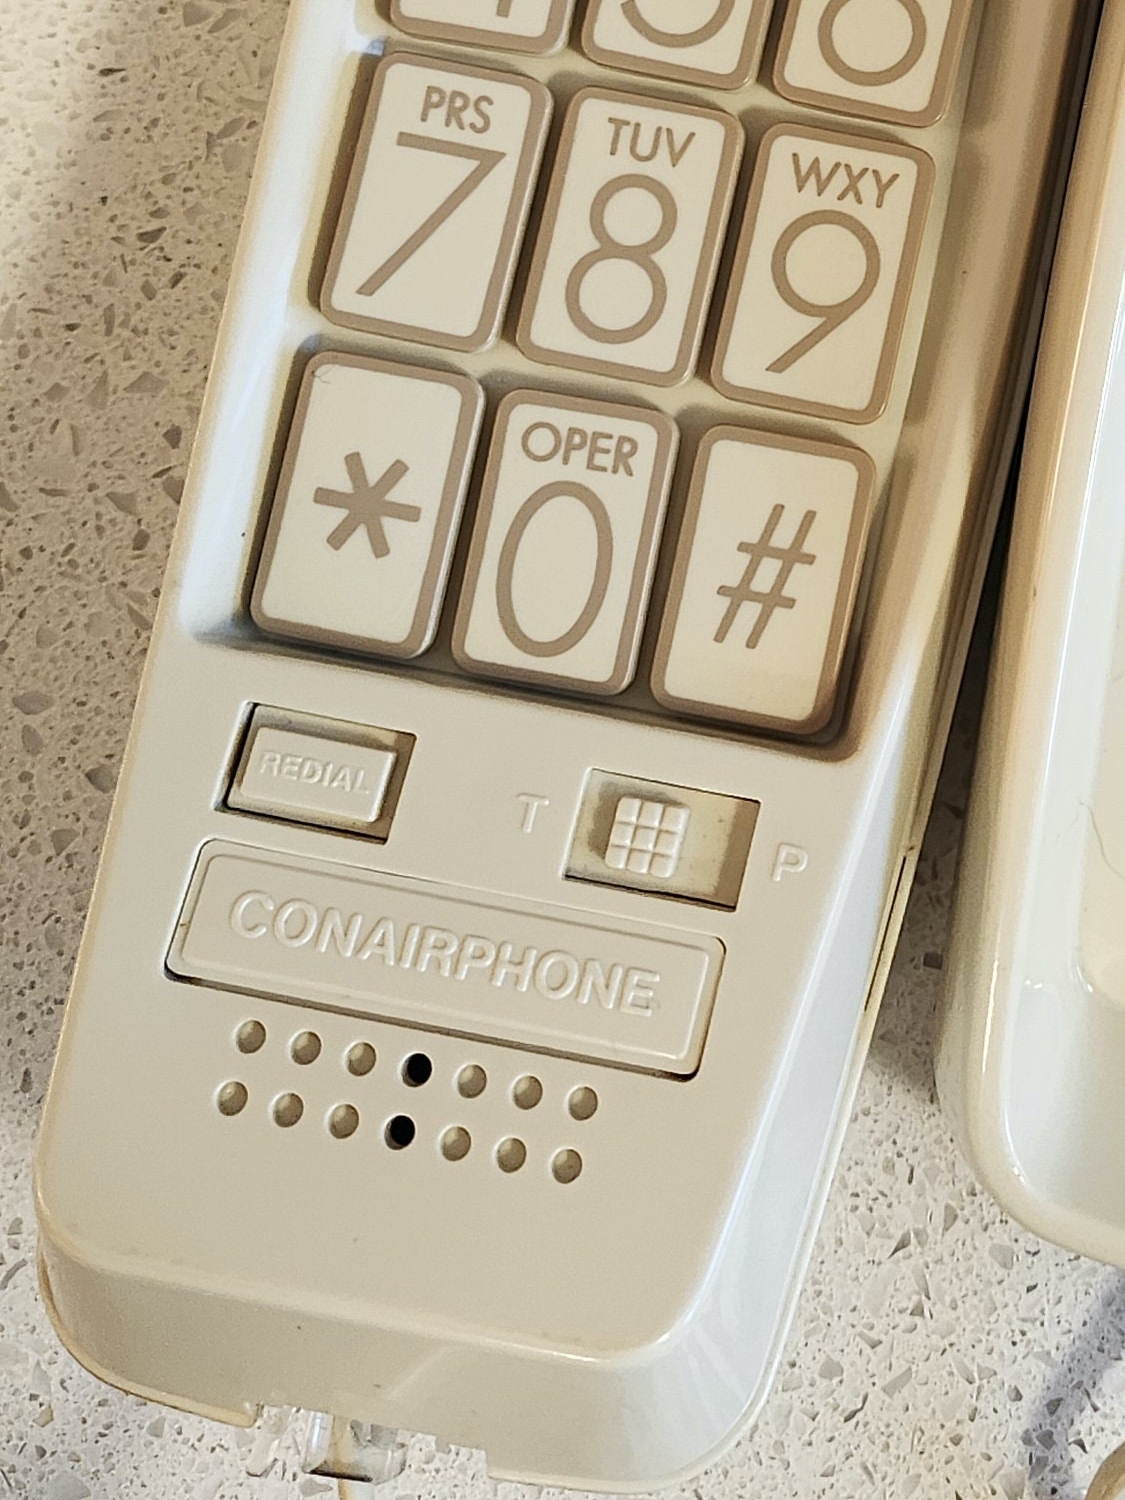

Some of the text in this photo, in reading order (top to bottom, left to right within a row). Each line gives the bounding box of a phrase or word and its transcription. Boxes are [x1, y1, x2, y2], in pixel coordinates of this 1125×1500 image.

[421, 85, 492, 134] PRS
[607, 117, 696, 168] TUV
[791, 152, 900, 209] WXY
[355, 131, 506, 297] 7
[565, 173, 678, 345] 8
[765, 209, 881, 374] 9
[521, 421, 637, 478] OPER
[498, 480, 613, 657] 0
[713, 503, 816, 650] #
[257, 750, 371, 796] REDIAL
[518, 794, 549, 835] T
[772, 843, 808, 882] P
[231, 890, 661, 1017] CONAIRPHONE
